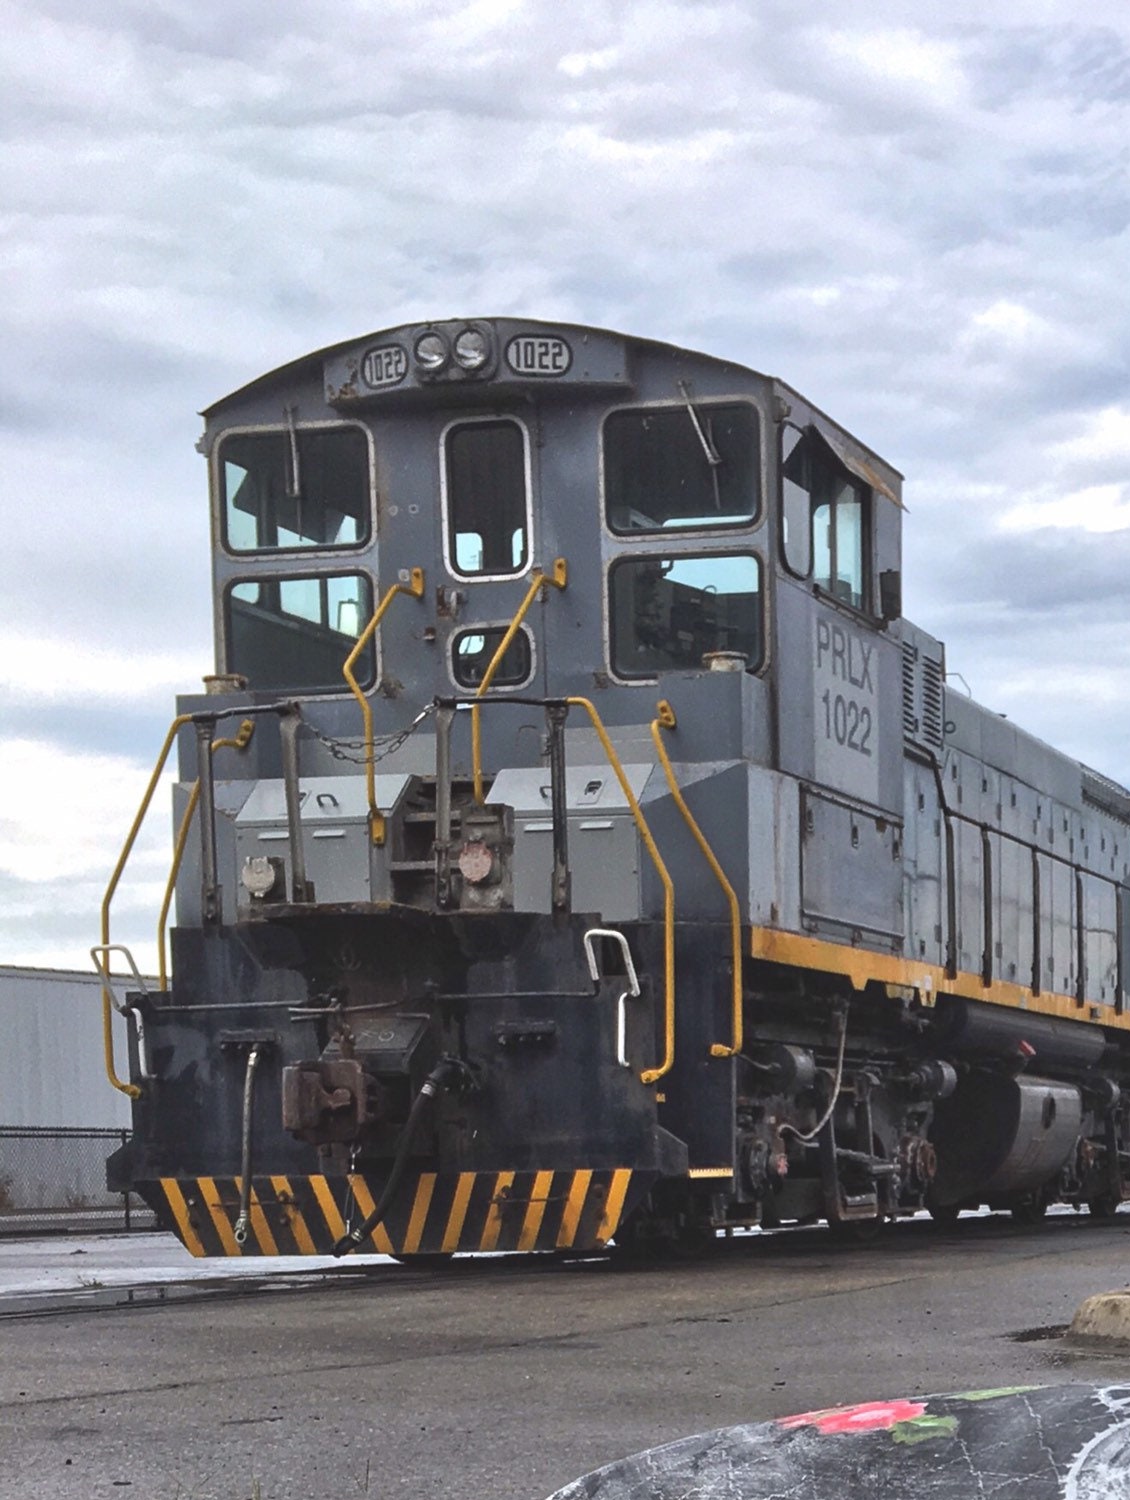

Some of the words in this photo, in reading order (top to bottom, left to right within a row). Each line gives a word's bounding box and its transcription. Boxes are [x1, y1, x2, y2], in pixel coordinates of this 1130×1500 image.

[367, 349, 404, 382] 1022
[515, 340, 564, 371] 1022
[816, 618, 873, 695] PRLX
[822, 689, 871, 757] 1022
